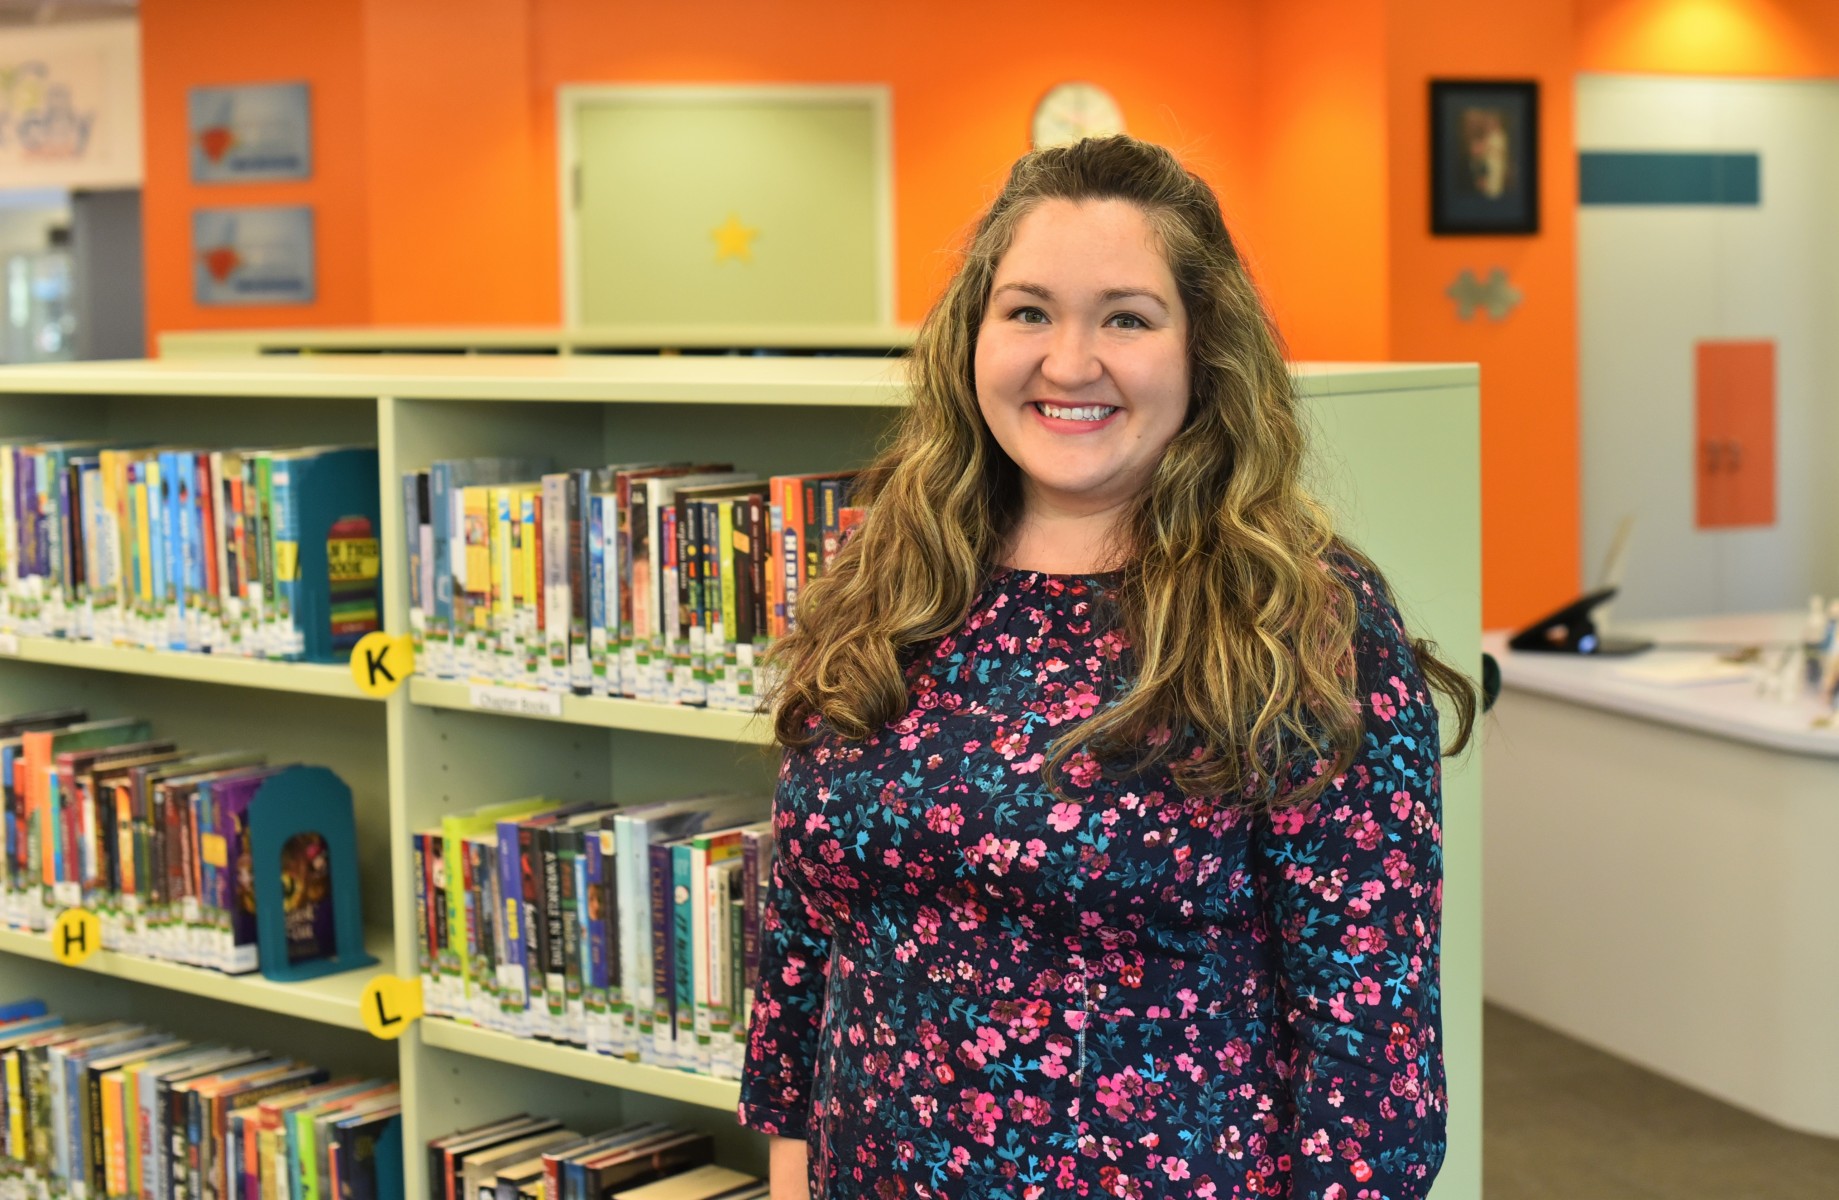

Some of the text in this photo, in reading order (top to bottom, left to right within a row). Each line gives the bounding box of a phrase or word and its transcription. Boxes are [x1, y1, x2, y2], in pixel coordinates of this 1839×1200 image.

[366, 645, 395, 686] K
[546, 862, 561, 916] WRINKLE
[63, 920, 86, 956] H
[654, 931, 668, 994] ENCHA
[375, 991, 402, 1026] L
